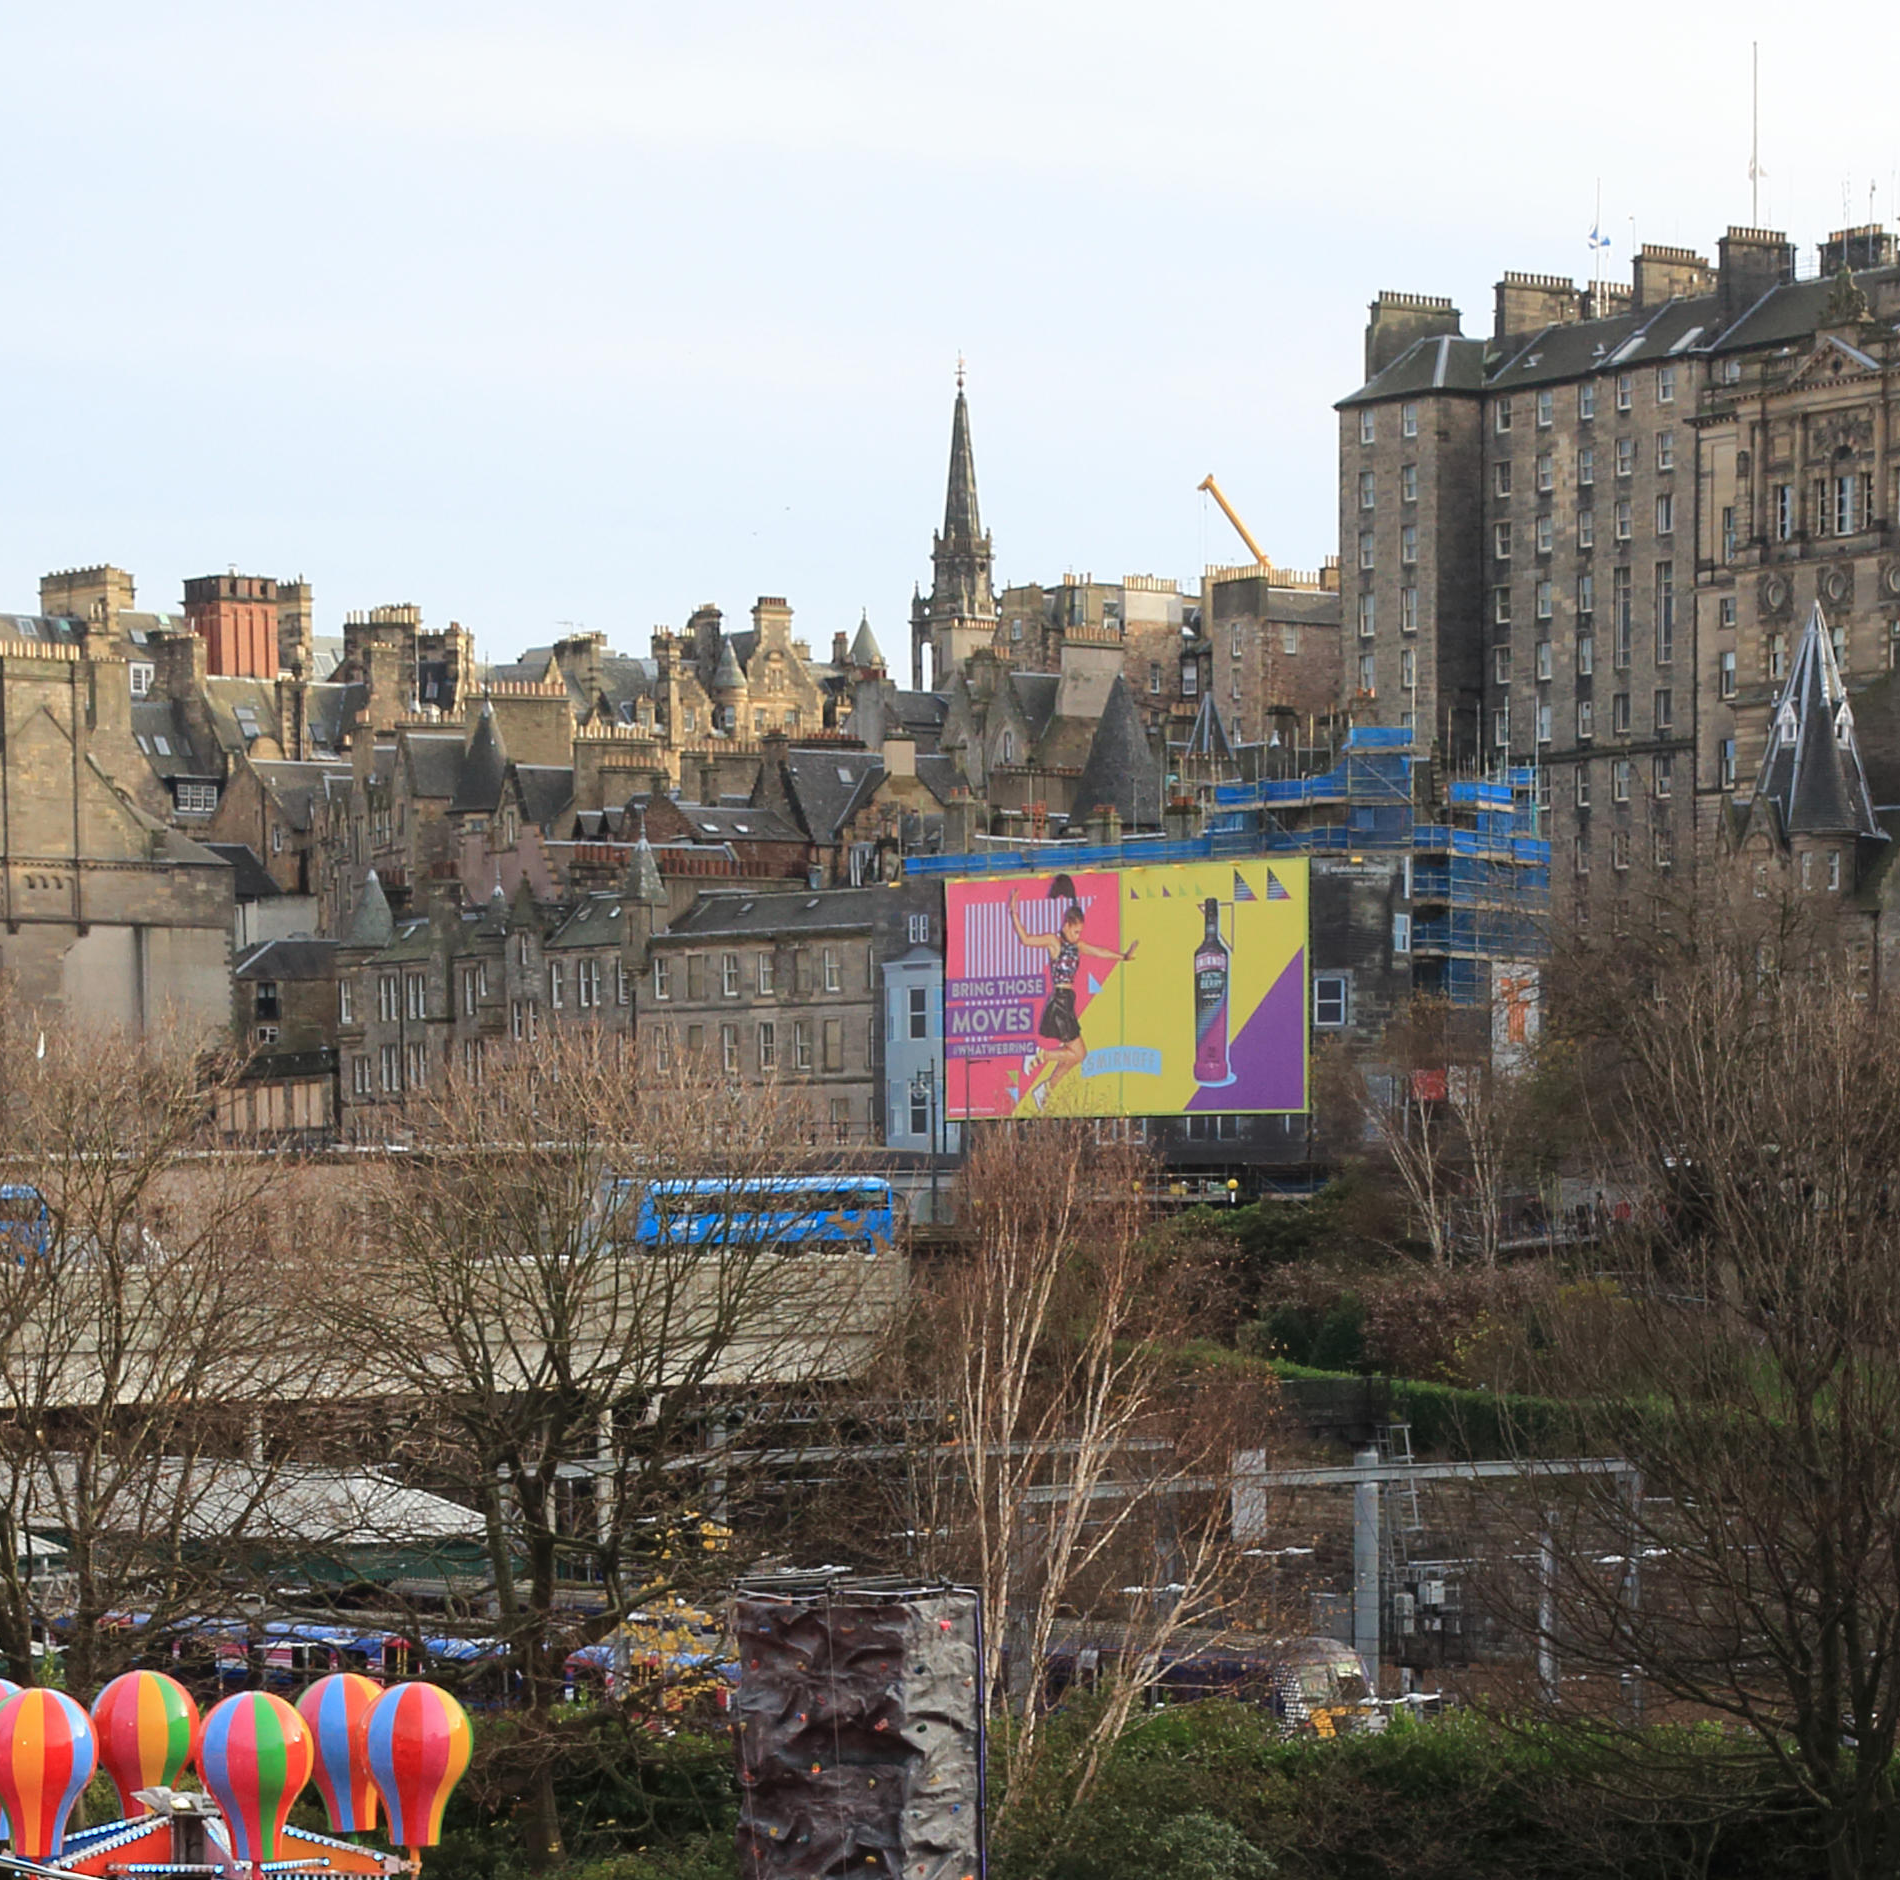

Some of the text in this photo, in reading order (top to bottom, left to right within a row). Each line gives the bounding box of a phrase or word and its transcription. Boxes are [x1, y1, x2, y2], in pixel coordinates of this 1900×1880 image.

[951, 976, 1044, 998] BRING THOSE
[951, 1006, 1032, 1033] MOVES
[1086, 1050, 1155, 1073] SMIRNOFF
